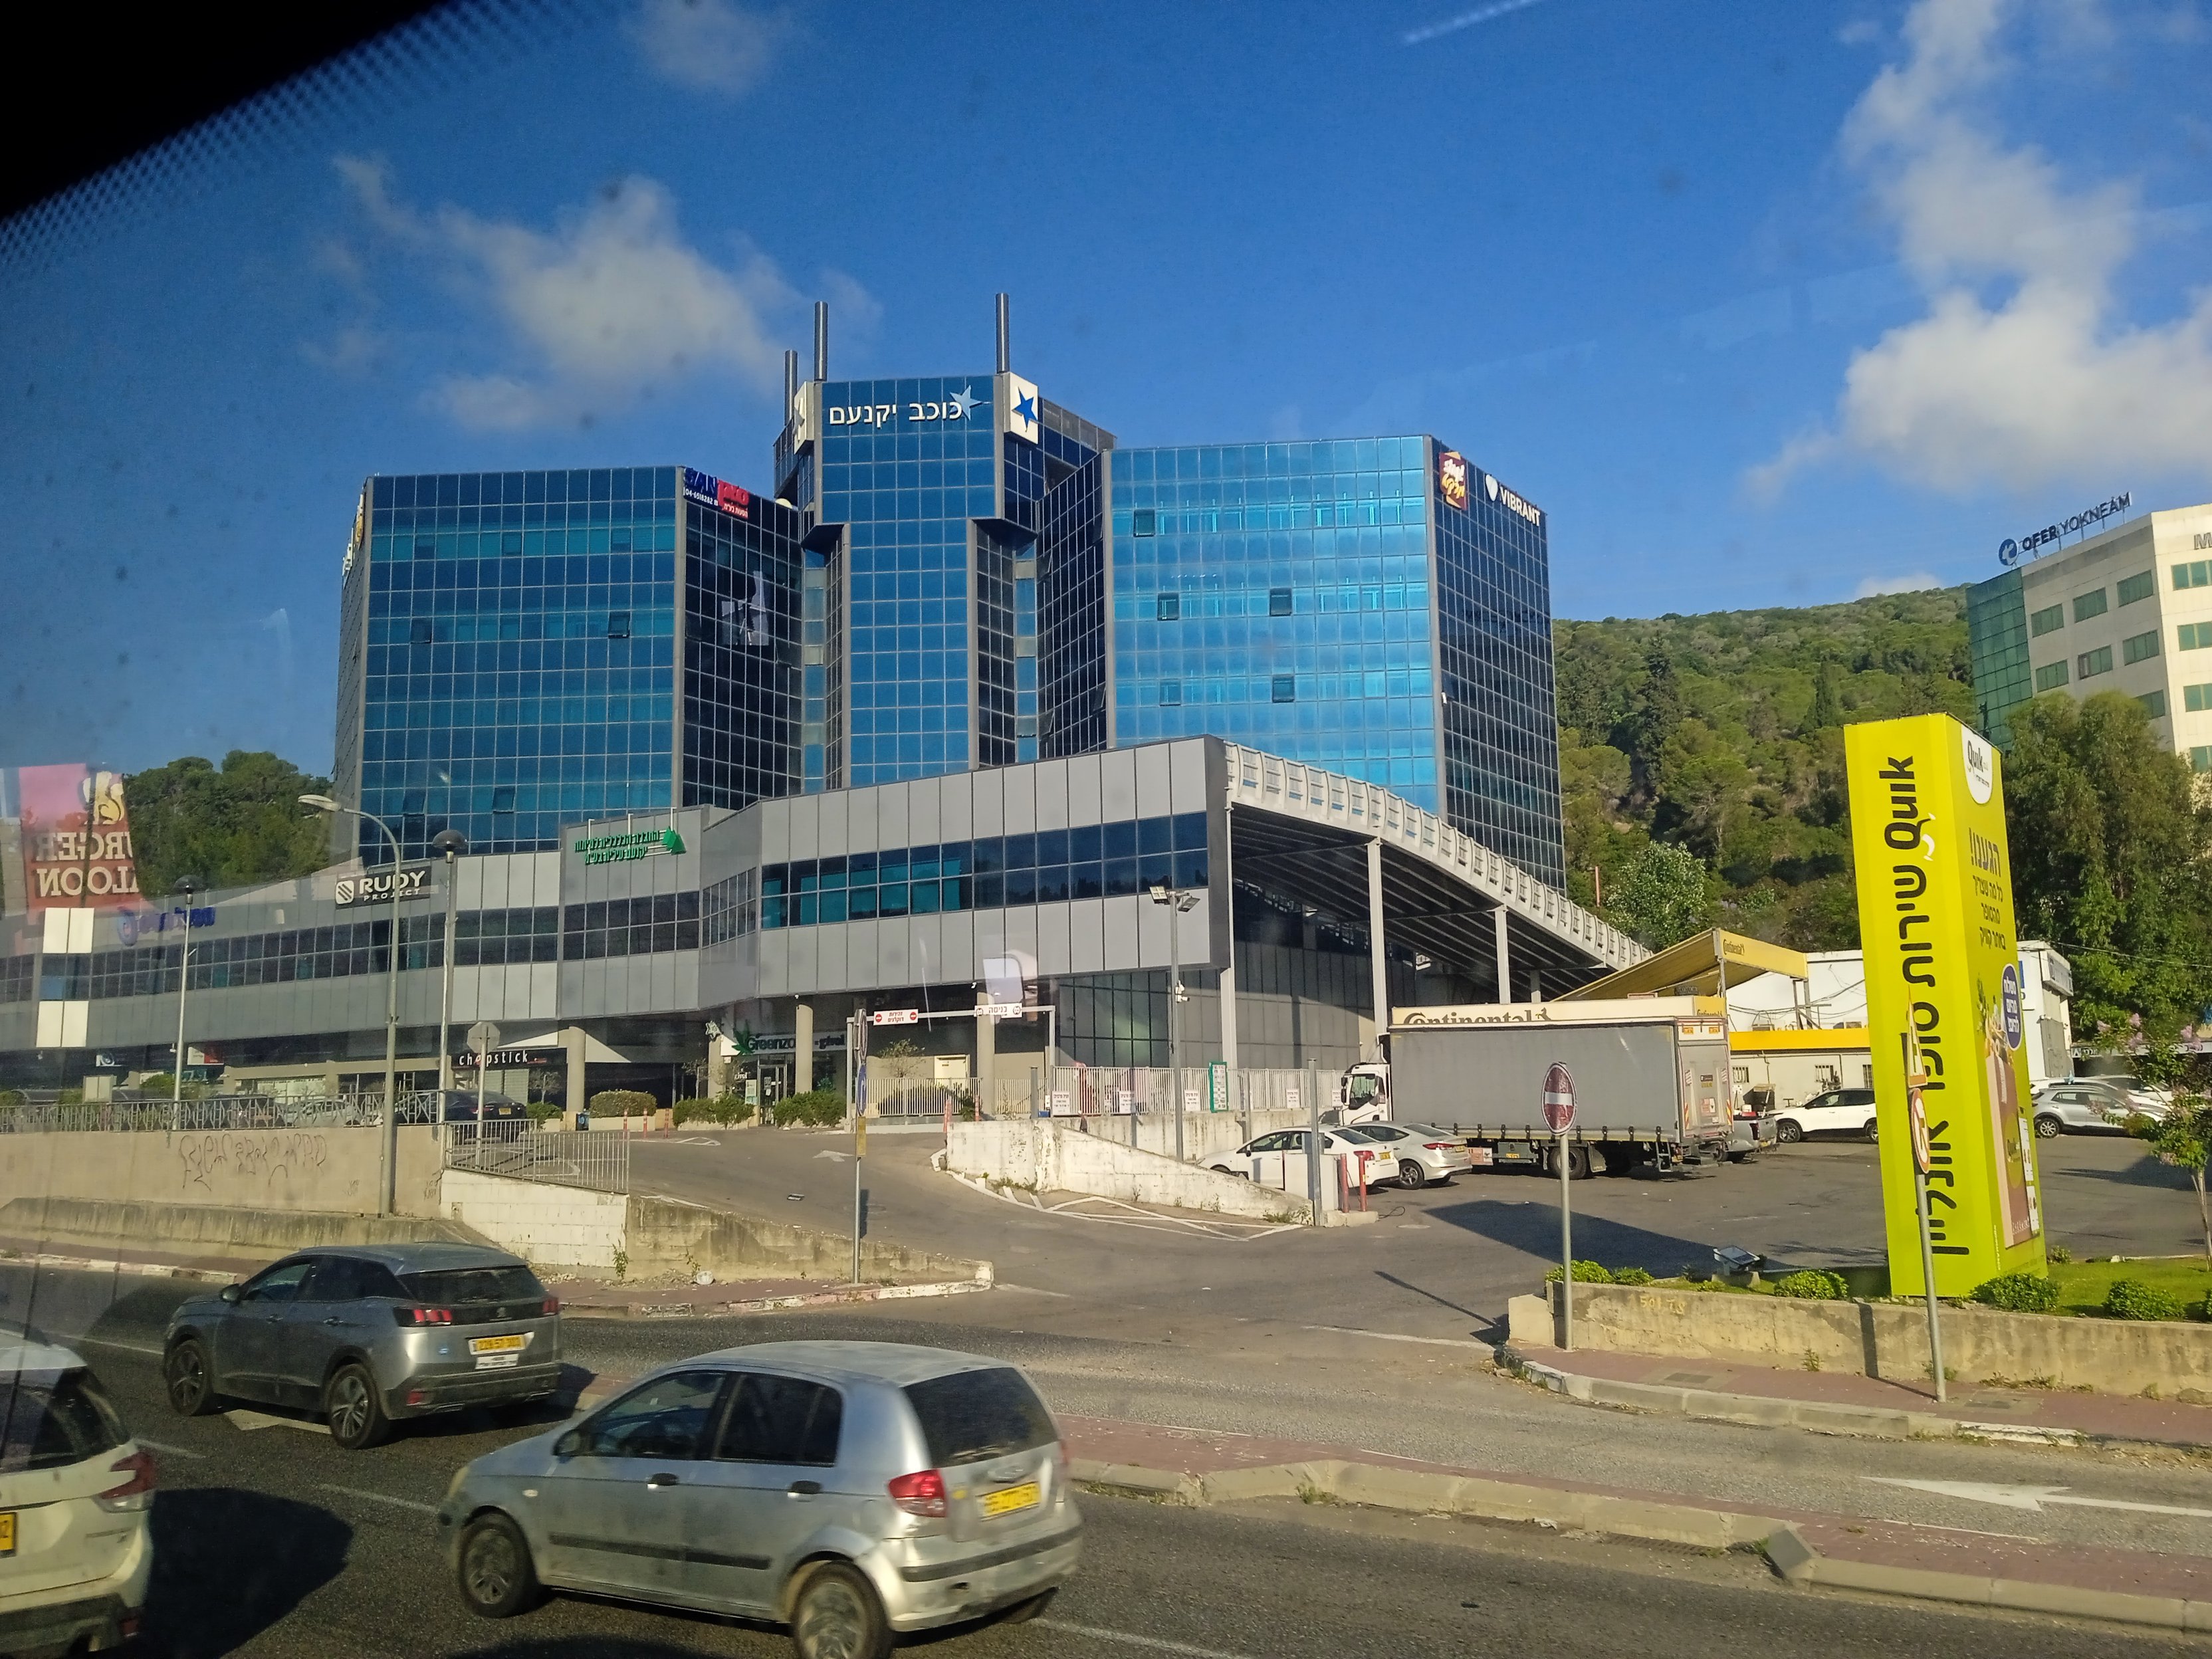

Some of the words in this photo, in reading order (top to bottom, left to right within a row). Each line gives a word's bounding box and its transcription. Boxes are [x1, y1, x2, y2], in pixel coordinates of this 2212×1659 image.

[830, 404, 897, 428] יקנעם
[909, 401, 962, 421] כוכב
[1499, 486, 1541, 526] VIBRANT
[2022, 524, 2058, 550] OFER
[2058, 492, 2132, 535] YOKNEAM
[1968, 740, 1984, 773] Quik
[1878, 756, 1932, 850] Quik
[1969, 828, 2001, 877] הגענו!
[359, 871, 425, 894] RUDY
[1996, 881, 2003, 903] כל
[1892, 864, 1936, 988] שירות
[747, 1035, 796, 1050] Greenzo
[459, 1050, 528, 1067] chopstick
